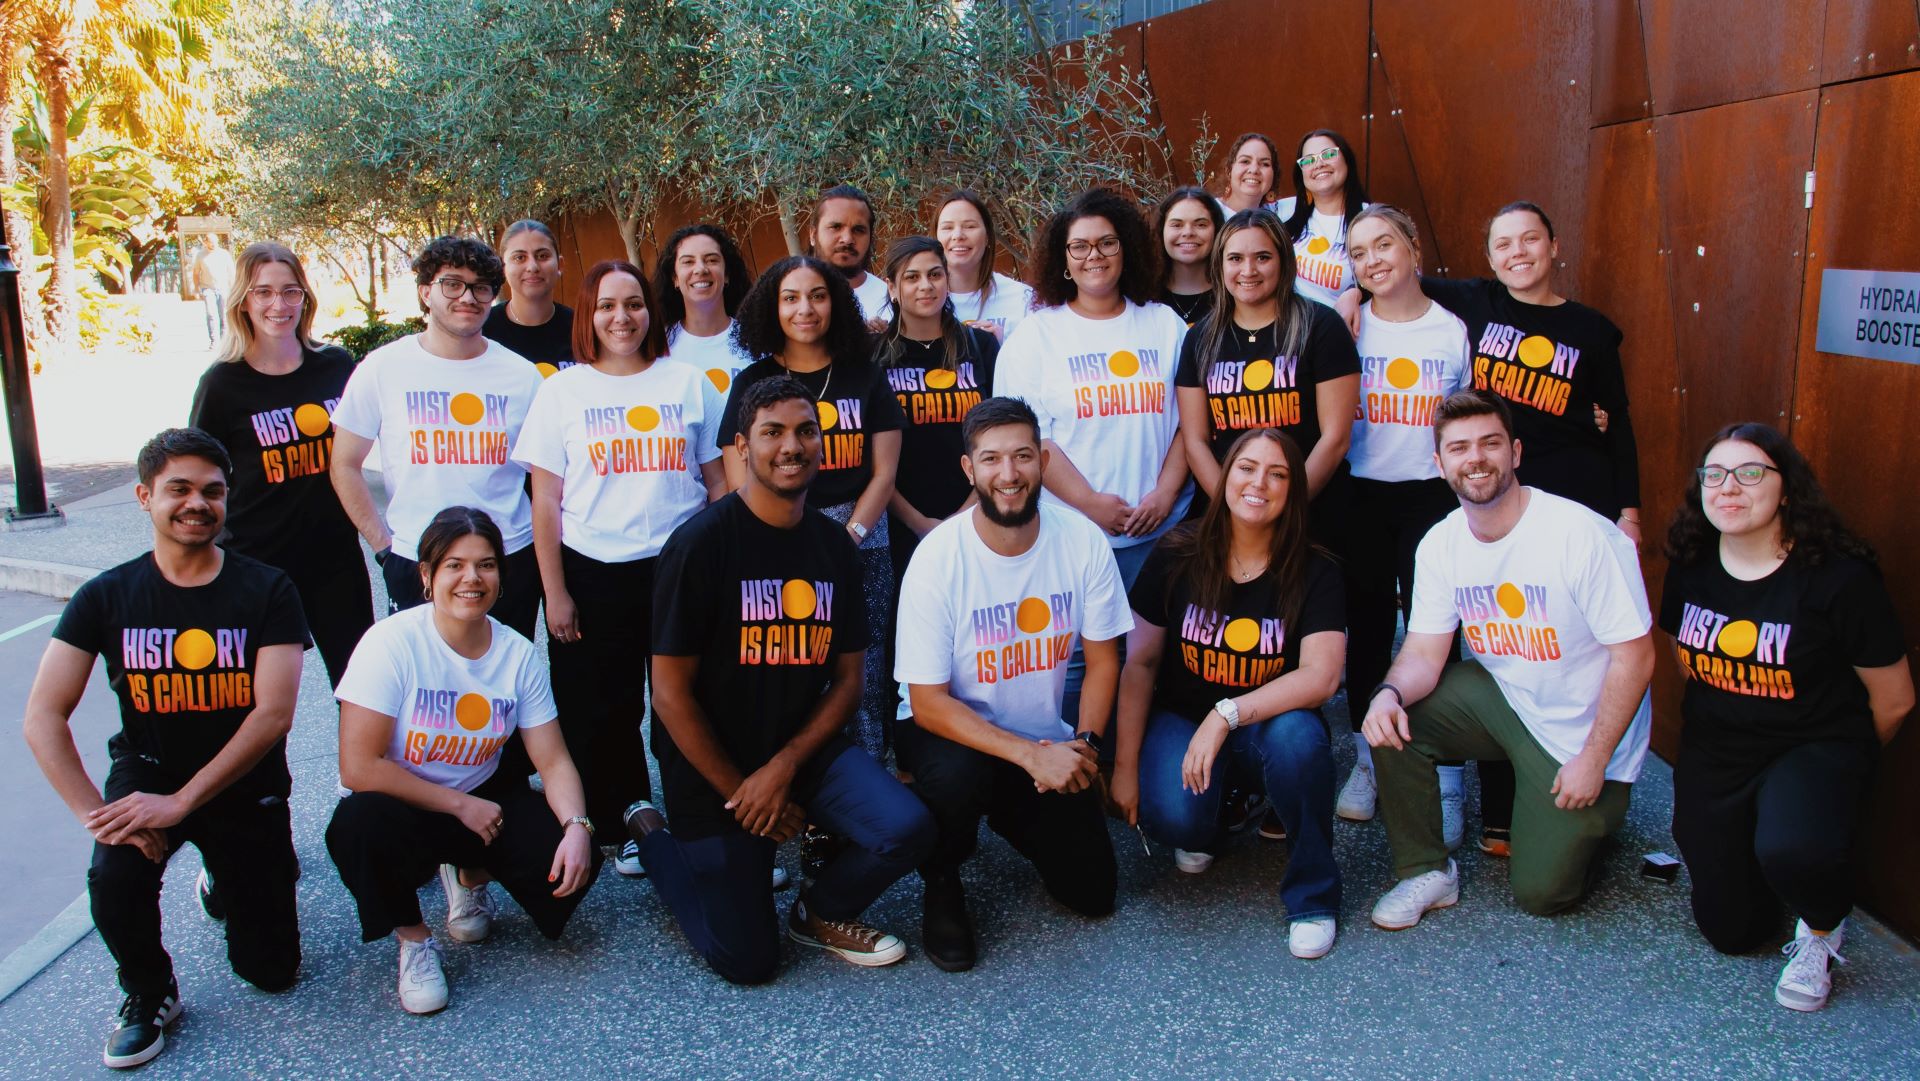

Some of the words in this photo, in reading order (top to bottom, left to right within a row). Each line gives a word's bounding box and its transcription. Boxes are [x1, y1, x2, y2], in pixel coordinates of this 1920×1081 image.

[1296, 255, 1342, 290] ALLING
[1860, 287, 1920, 313] HYDRA
[1068, 349, 1159, 384] HISTORY
[1478, 322, 1580, 380] HISTORY
[886, 361, 978, 392] HISTORY
[1207, 355, 1298, 395] HISTORY
[1359, 356, 1444, 390] STORY
[1474, 356, 1490, 391] IS
[1490, 361, 1572, 417] CALLING
[405, 391, 508, 426] HISTORY
[1074, 386, 1094, 419] IS
[1097, 381, 1166, 417] CALLING
[1209, 398, 1227, 430] IS
[1226, 391, 1301, 430] CALLING
[584, 403, 684, 438] HISTORY
[262, 449, 285, 484] IS
[410, 429, 428, 465] IS
[433, 429, 509, 465] CALLING
[587, 441, 608, 476] IS
[611, 437, 687, 474] CALLING
[741, 578, 833, 622] HISTORY
[973, 591, 1073, 647] HISTORY
[1455, 583, 1548, 622] HISTORY
[122, 627, 248, 670] HISTORY
[740, 625, 763, 665] IS
[765, 624, 833, 666] CALLNG
[1181, 603, 1285, 655] HISTORY
[1462, 625, 1486, 655] IS
[1678, 602, 1792, 666] HISTORY
[976, 649, 997, 685] IS
[1181, 641, 1199, 676] IS
[1696, 653, 1795, 700] CALLING
[127, 673, 151, 713] IS
[153, 672, 251, 714] CALLING
[410, 687, 515, 733] HISTORY
[404, 730, 429, 766] IS
[426, 734, 509, 767] CALLIN
